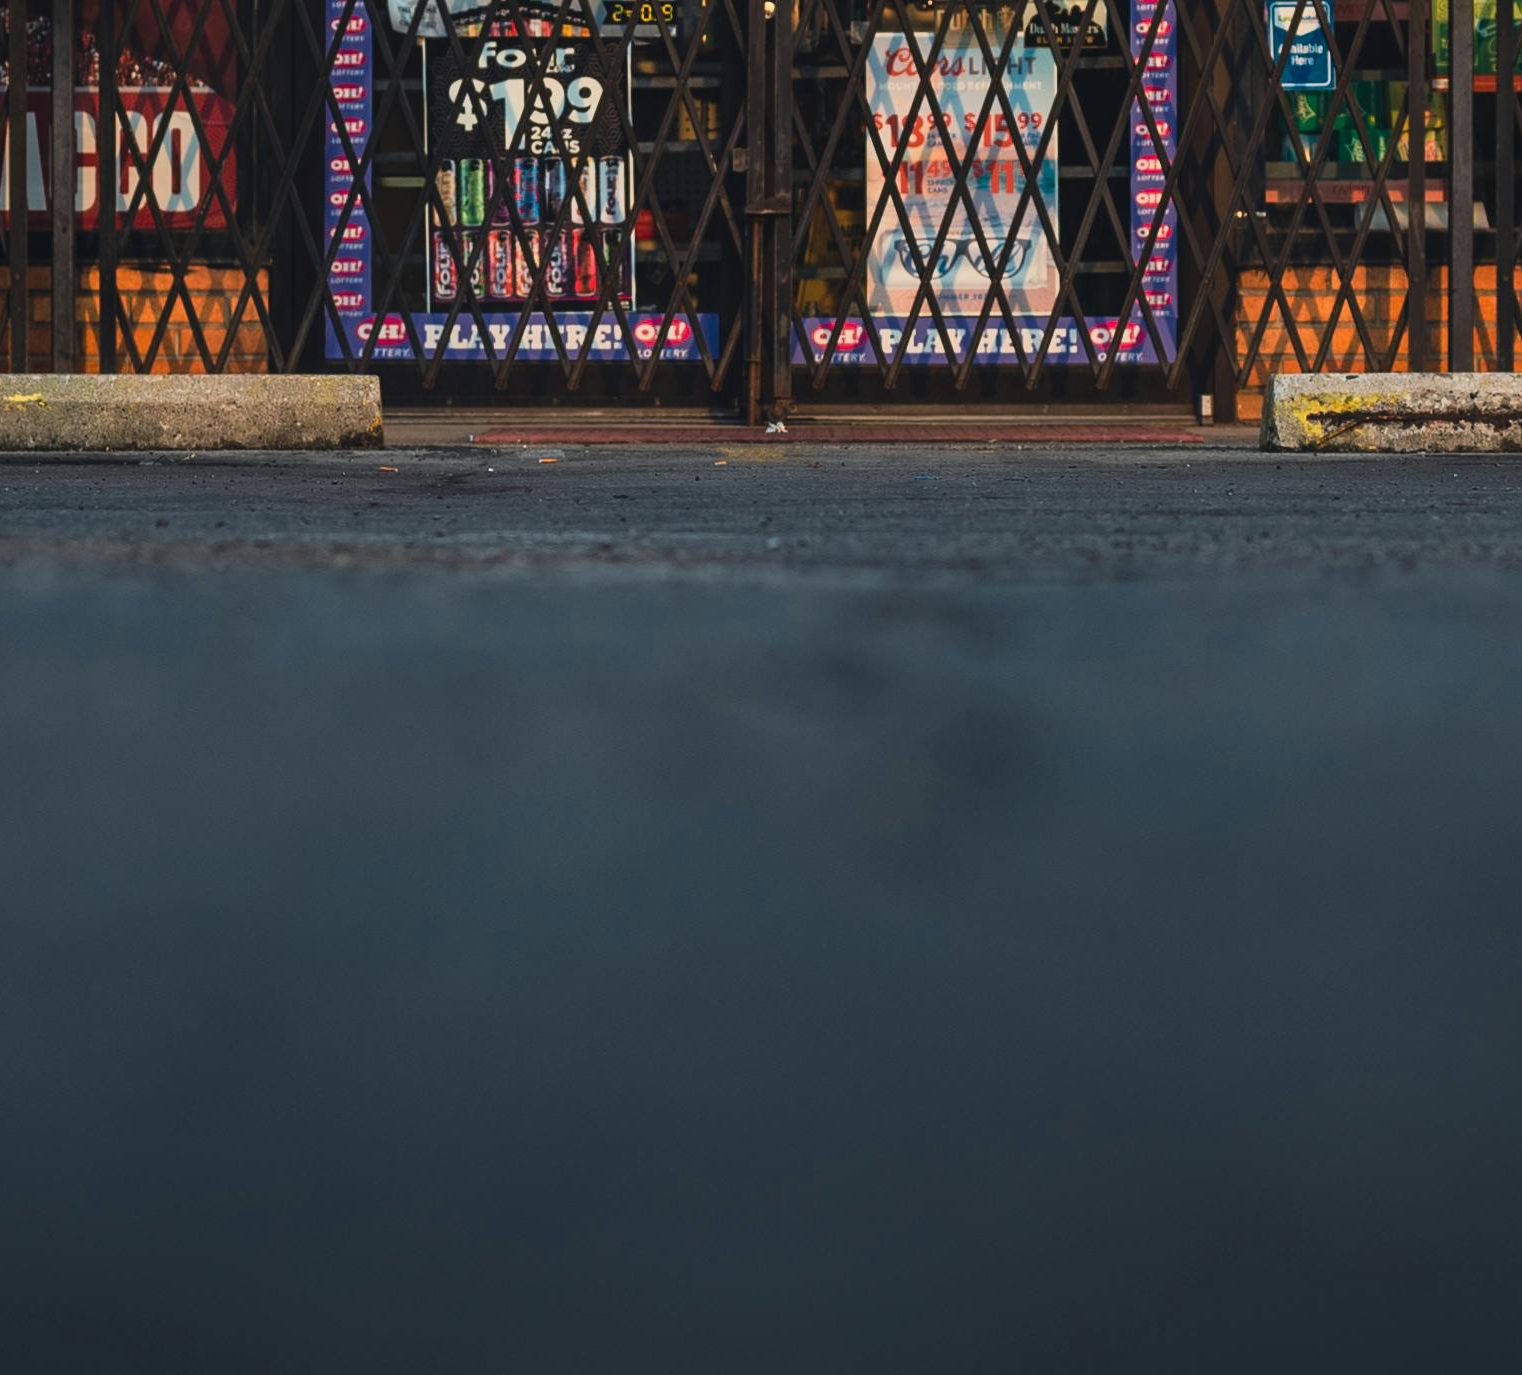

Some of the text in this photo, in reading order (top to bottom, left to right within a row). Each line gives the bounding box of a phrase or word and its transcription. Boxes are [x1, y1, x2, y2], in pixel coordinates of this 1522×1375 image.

[1029, 21, 1059, 35] Duh
[1278, 42, 1323, 55] ailable
[884, 46, 1037, 77] Cors LIHT
[1291, 56, 1315, 66] Here
[531, 126, 553, 140] 24
[1137, 174, 1166, 182] LOTTER
[423, 324, 512, 350] PLAY
[879, 328, 967, 354] PLAY
